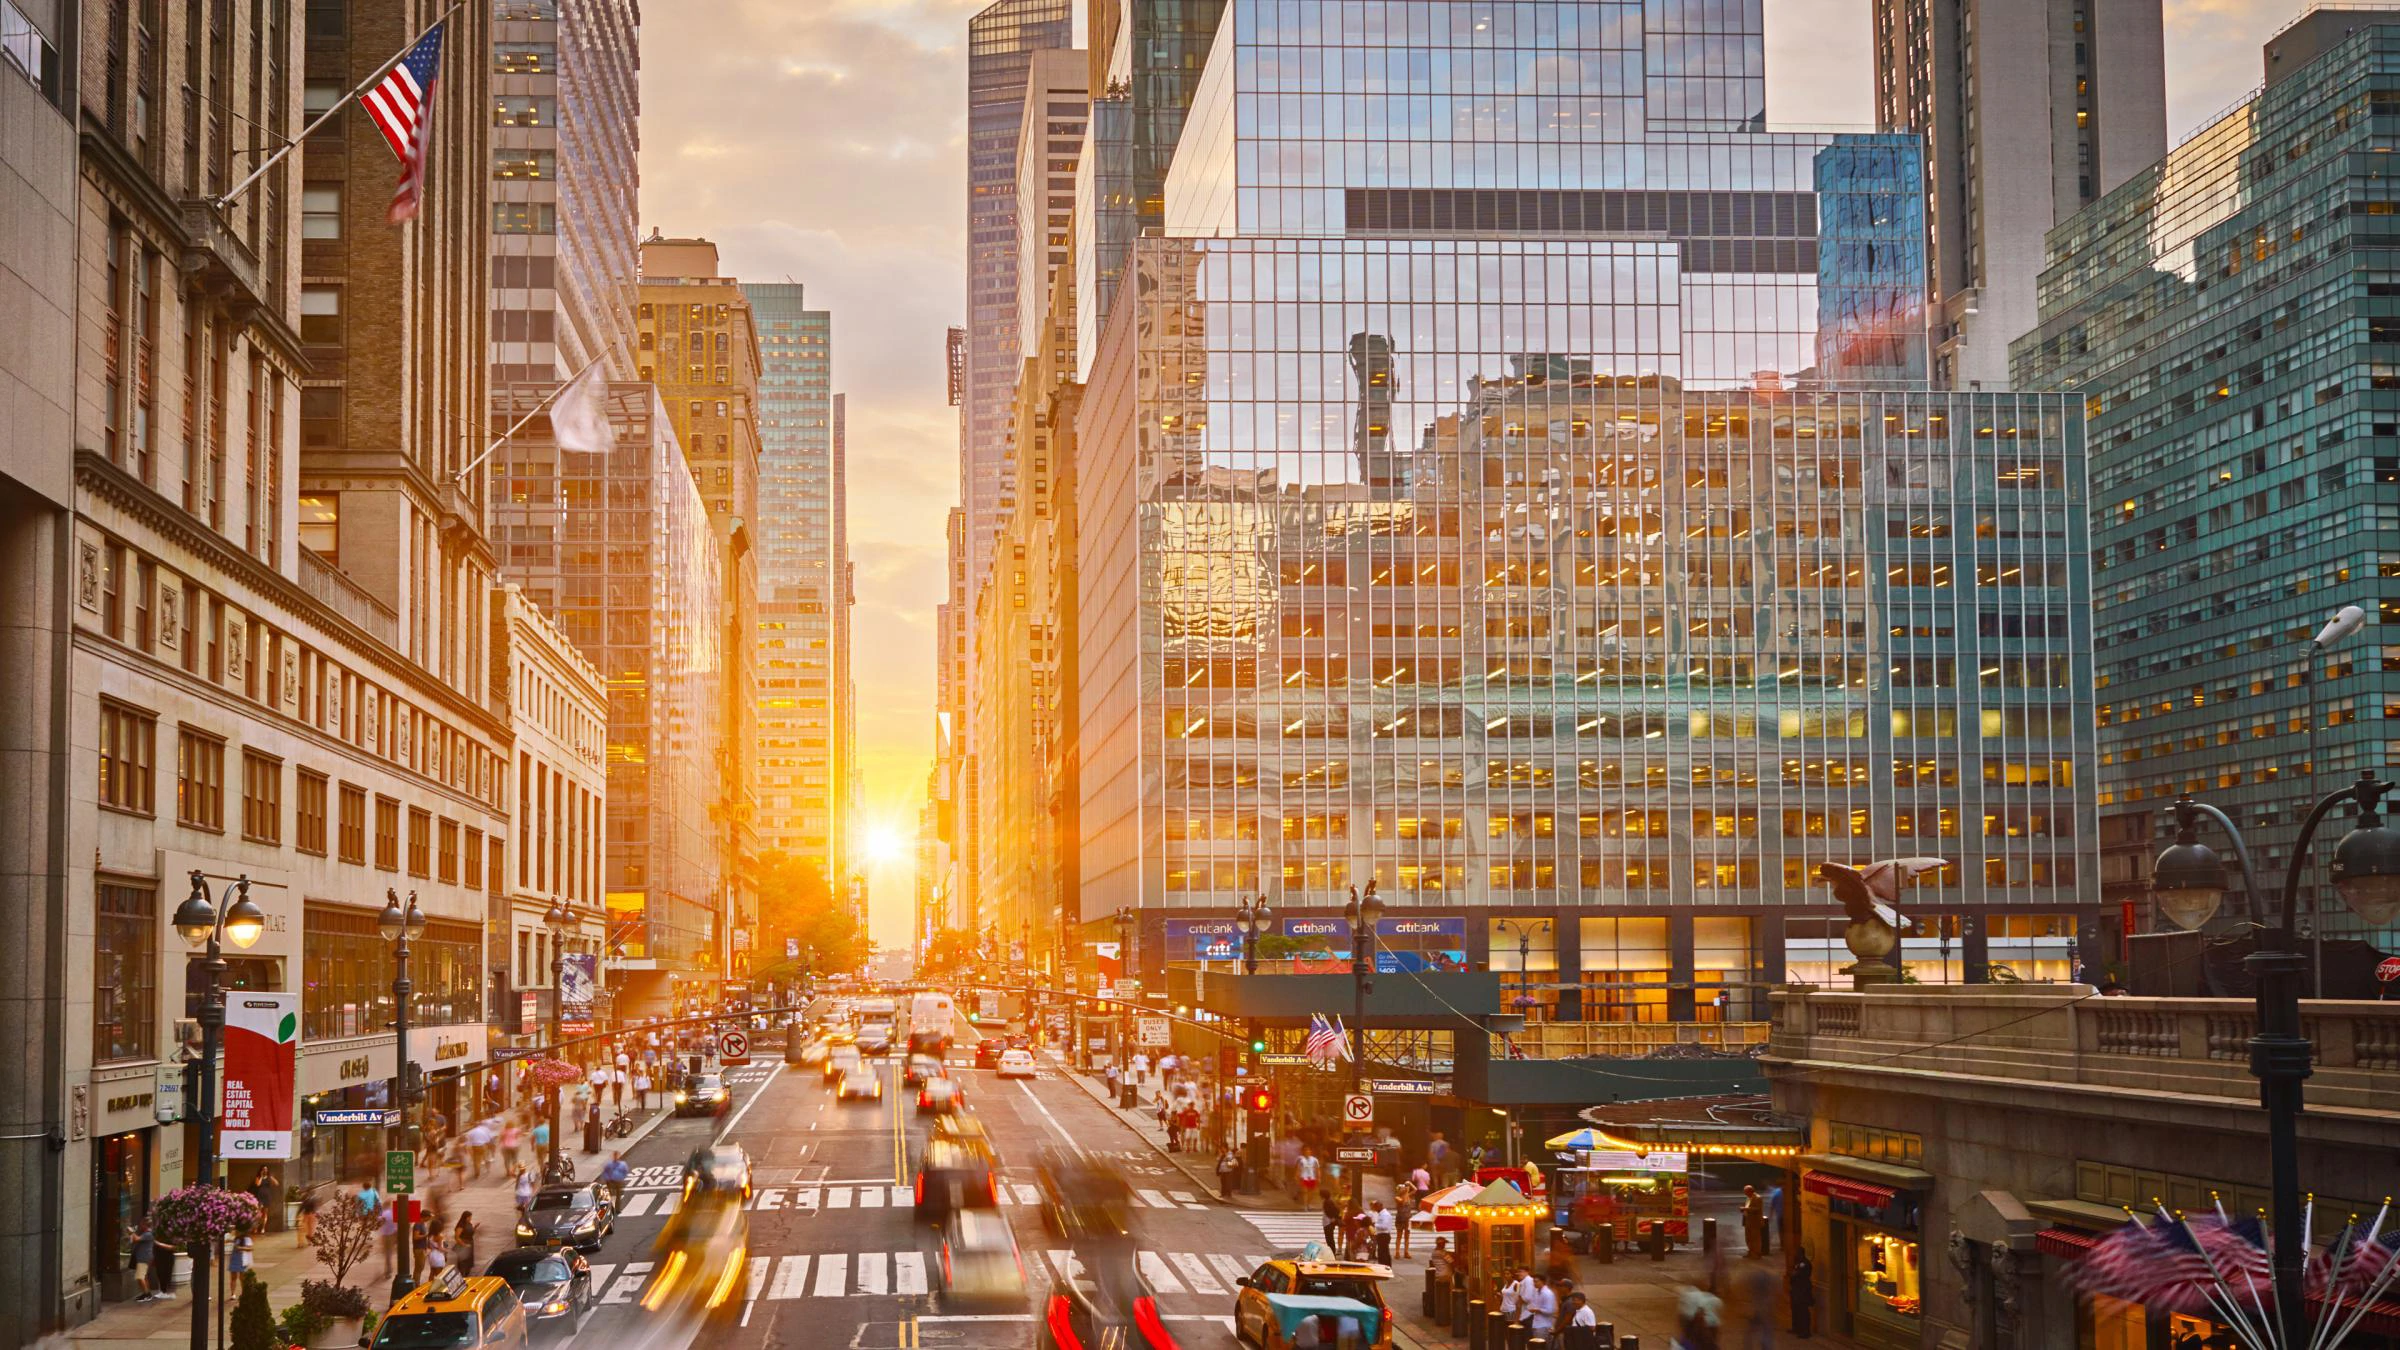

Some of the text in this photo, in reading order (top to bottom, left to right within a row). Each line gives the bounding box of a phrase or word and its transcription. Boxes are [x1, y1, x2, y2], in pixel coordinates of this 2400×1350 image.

[1188, 924, 1233, 934] citibank
[1293, 924, 1337, 934] citibank
[1396, 922, 1440, 933] citibank
[2379, 964, 2400, 974] STOP
[226, 1080, 244, 1090] REAL
[1372, 1082, 1415, 1091] Vanderbilt
[1416, 1083, 1433, 1092] Ave
[226, 1090, 252, 1099] ESTATE
[225, 1100, 254, 1109] CAPITAL
[225, 1109, 249, 1118] OF THE
[319, 1113, 368, 1123] Vanderbilt
[369, 1113, 383, 1121] Av
[225, 1119, 251, 1128] WORLD
[234, 1140, 277, 1150] CBRE
[623, 1175, 683, 1187] ONL
